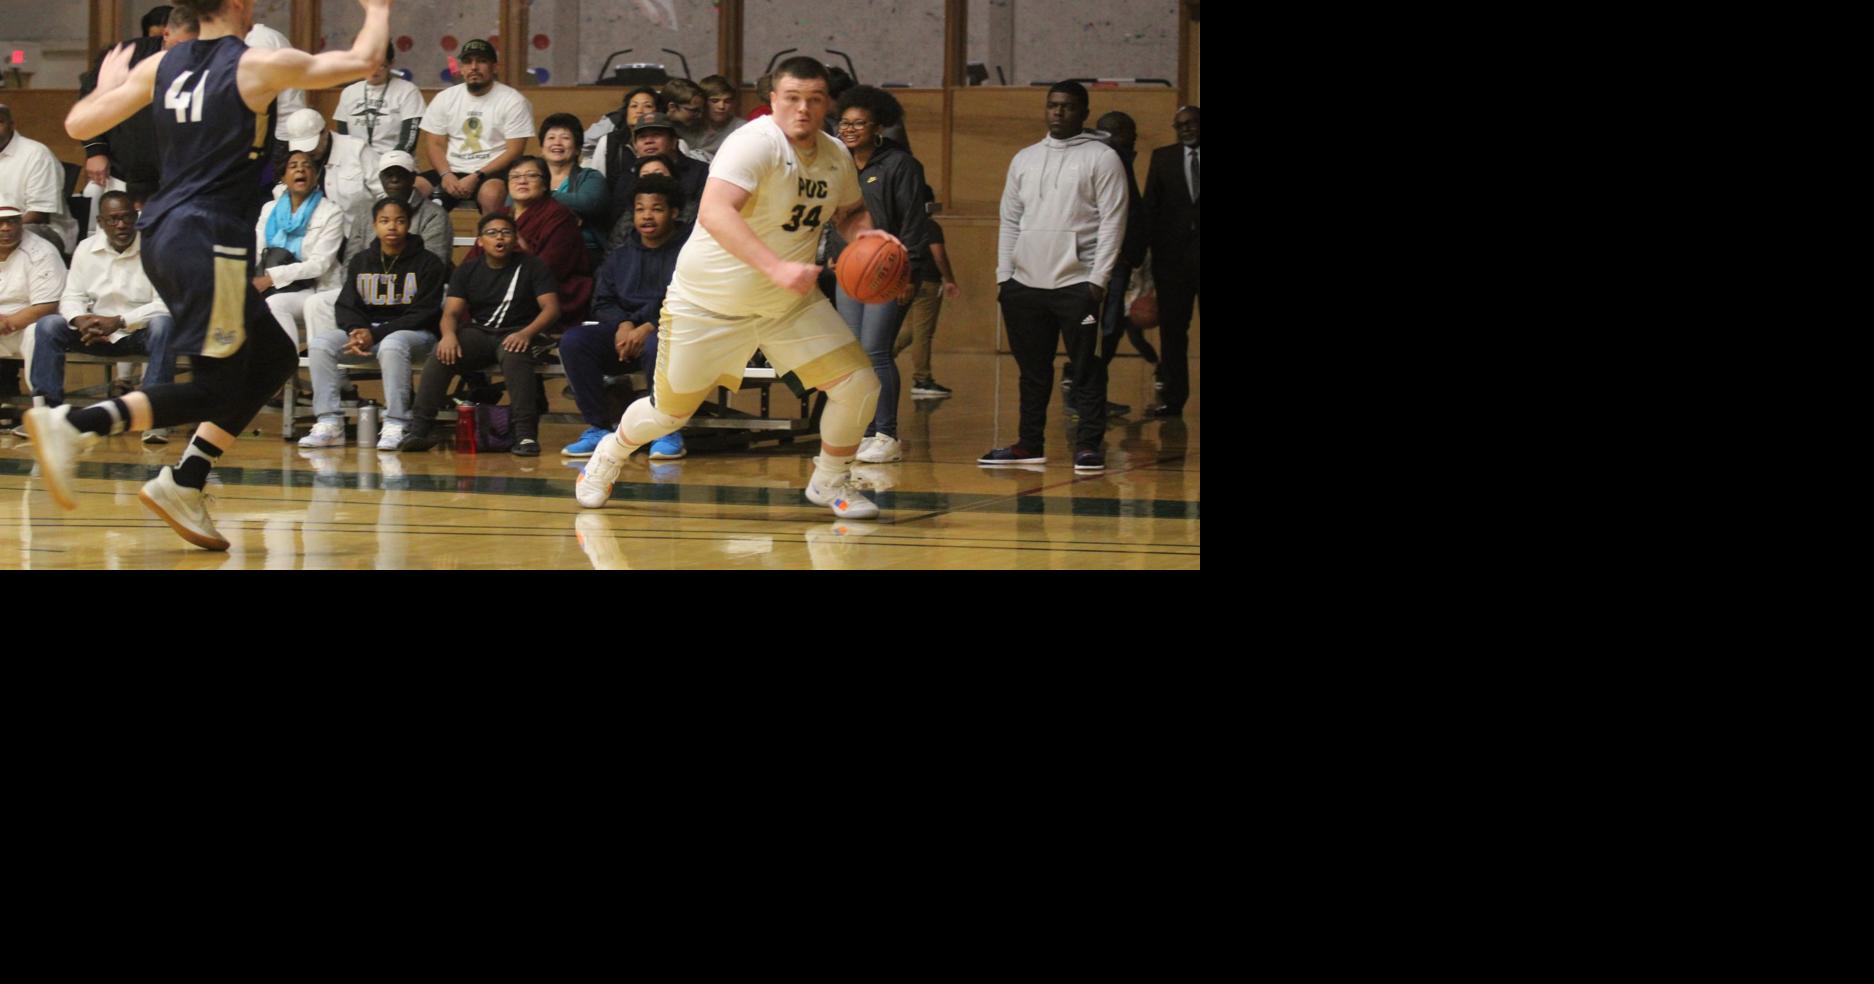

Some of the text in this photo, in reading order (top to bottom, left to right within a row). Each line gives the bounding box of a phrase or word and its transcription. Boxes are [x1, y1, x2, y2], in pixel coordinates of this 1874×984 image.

[164, 69, 210, 124] 41
[798, 177, 828, 198] PUC
[782, 204, 822, 232] 34
[357, 272, 417, 305] UCLA
